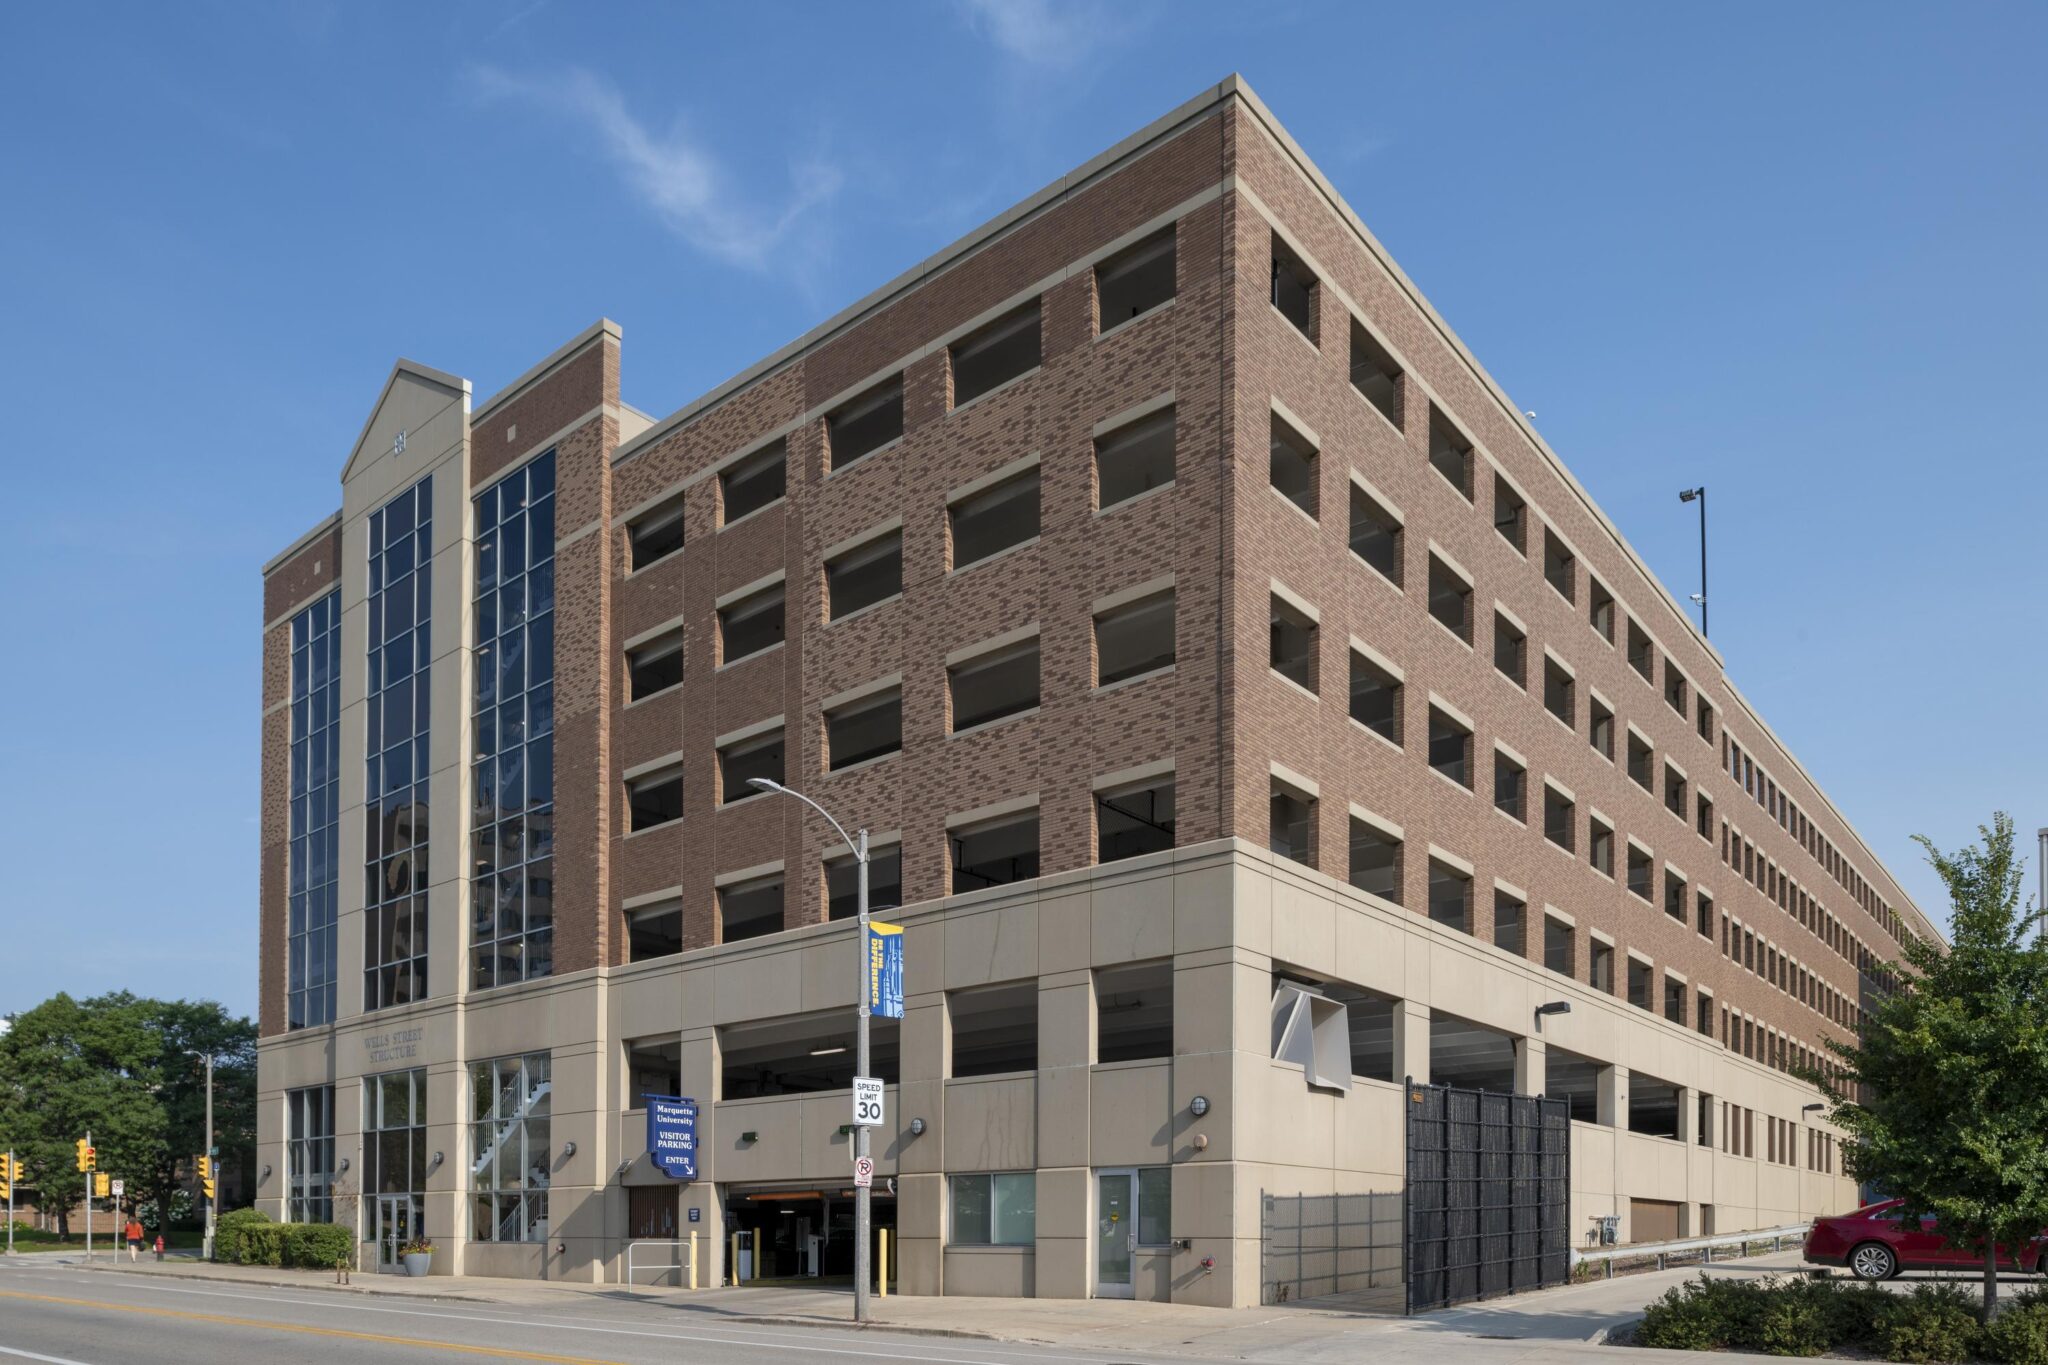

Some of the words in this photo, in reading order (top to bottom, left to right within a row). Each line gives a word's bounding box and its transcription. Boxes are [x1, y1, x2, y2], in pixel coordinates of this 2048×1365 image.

[364, 1034, 389, 1049] WELLS
[392, 1027, 423, 1044] STREET
[370, 1044, 416, 1063] STRUCTURE
[857, 1083, 881, 1092] SPEED
[860, 1093, 877, 1101] LIMIT
[657, 1105, 693, 1116] Marquette
[858, 1101, 881, 1119] 30
[657, 1115, 693, 1126] University
[659, 1131, 691, 1141] VISITOR
[657, 1140, 692, 1150] PARKING
[665, 1156, 689, 1165] ENTER
